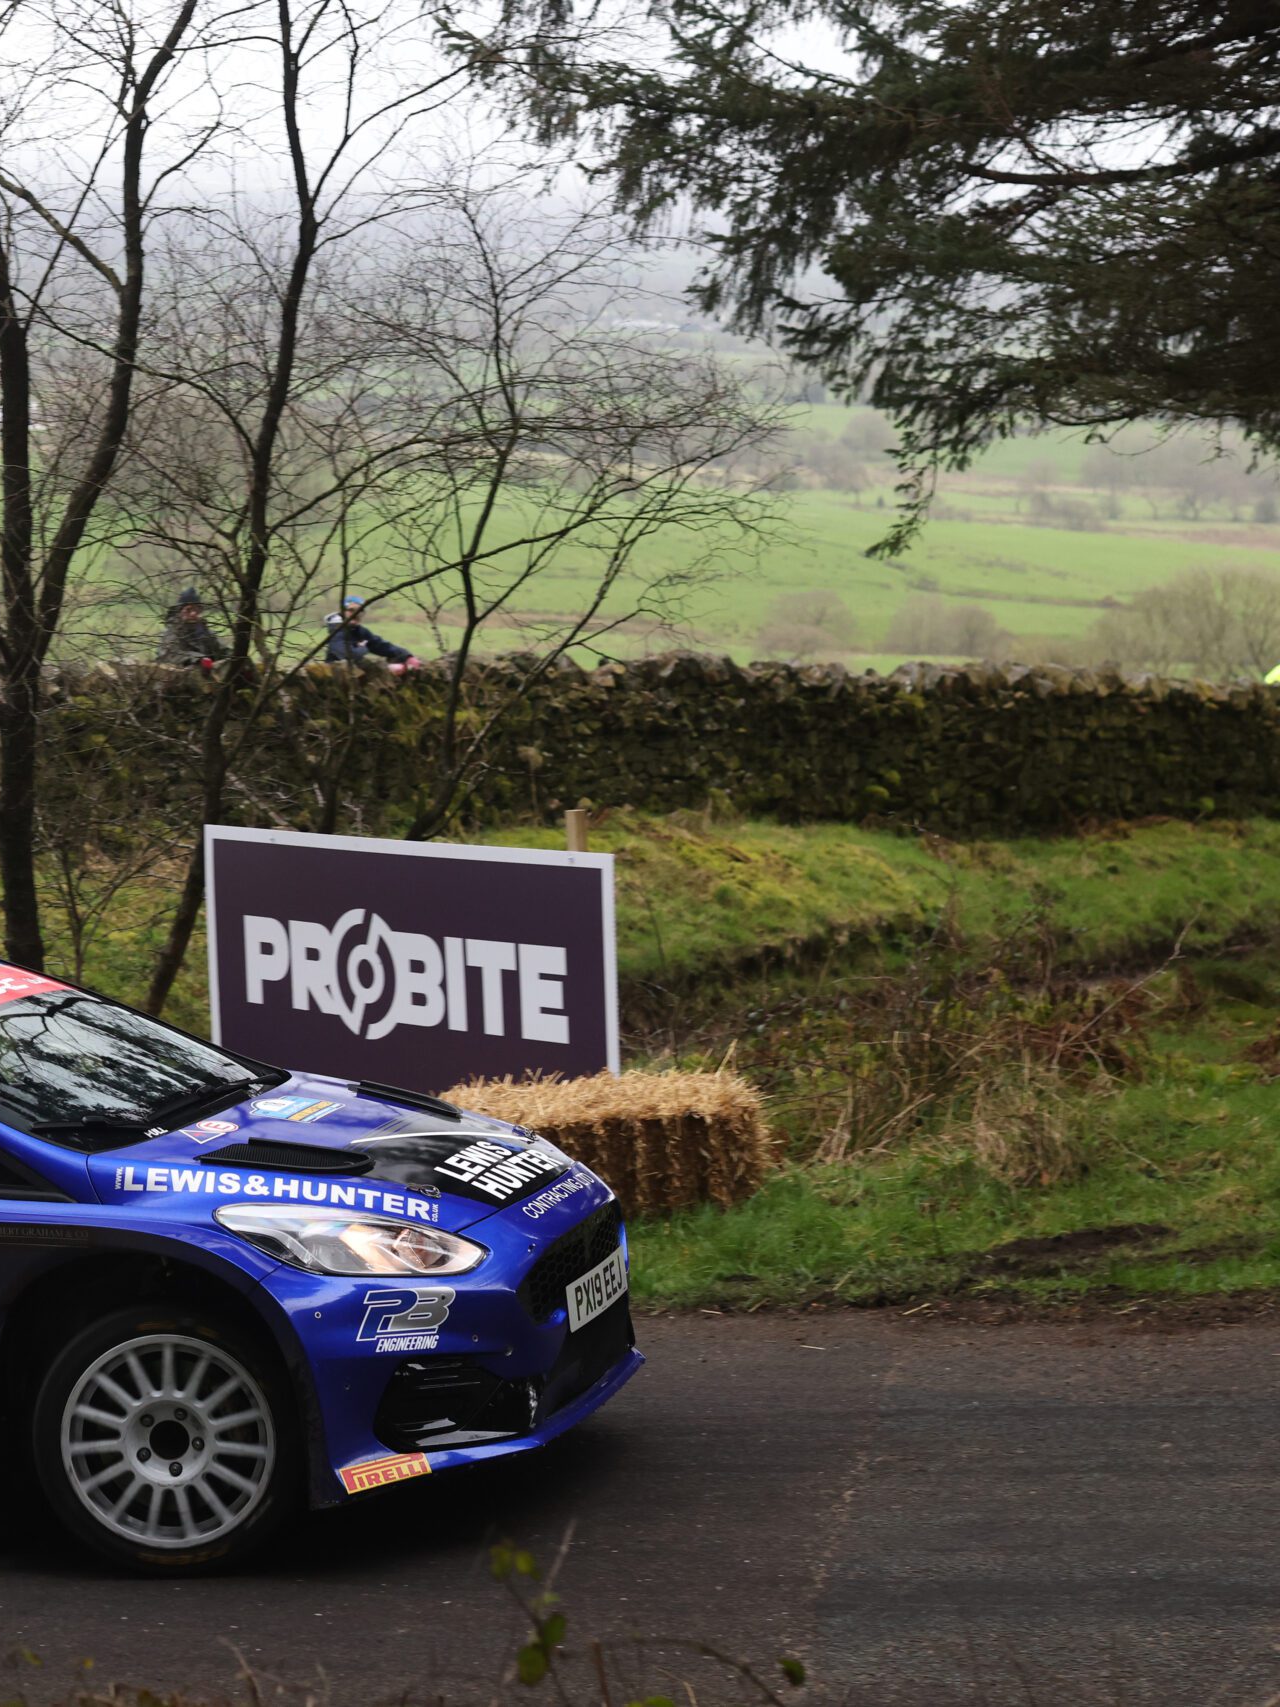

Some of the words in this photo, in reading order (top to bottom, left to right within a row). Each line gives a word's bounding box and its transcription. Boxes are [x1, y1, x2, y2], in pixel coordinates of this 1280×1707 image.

[242, 908, 570, 1045] PROBITE
[433, 1140, 513, 1183] LEWIS
[471, 1149, 564, 1200] HUNTER
[123, 1166, 431, 1222] LEWIS&HUNTER
[522, 1178, 583, 1219] CONTRACTING
[356, 1286, 456, 1341] PB
[575, 1275, 604, 1321] PX19
[604, 1255, 624, 1302] EEJ
[375, 1335, 439, 1353] ENGINEERING
[340, 1452, 429, 1492] PIRELLI
